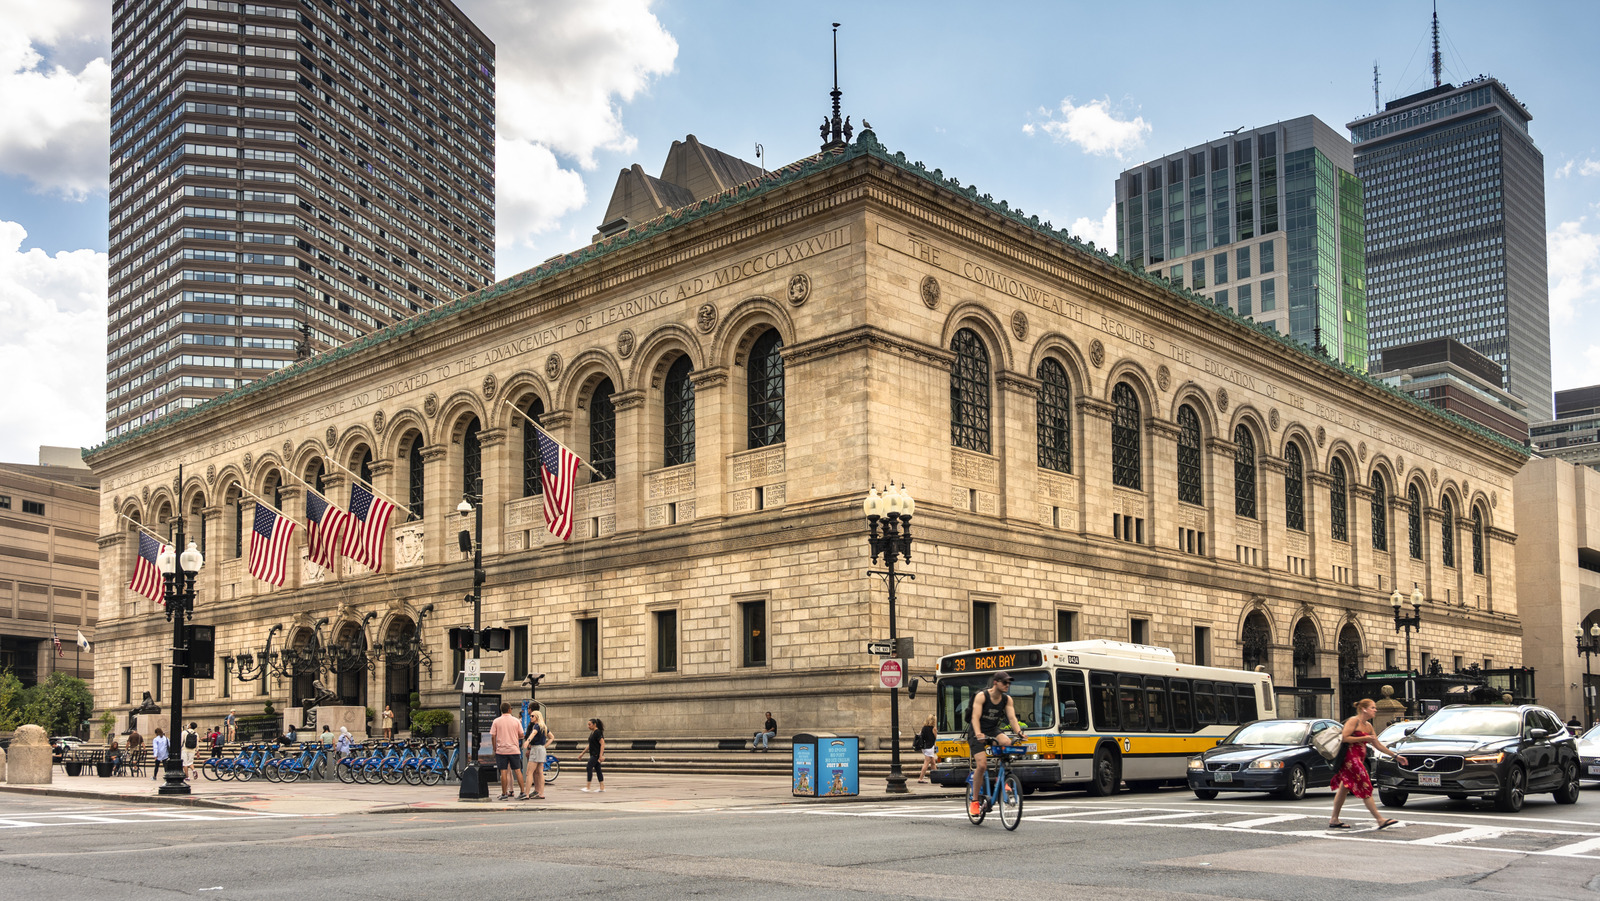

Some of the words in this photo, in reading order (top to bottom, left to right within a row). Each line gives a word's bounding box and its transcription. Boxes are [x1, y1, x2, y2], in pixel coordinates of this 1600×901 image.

[1373, 95, 1468, 129] PRUDENTIAL
[164, 461, 172, 472] OF
[191, 449, 206, 463] CITY
[210, 445, 219, 455] OF
[222, 435, 251, 452] BOSTON
[255, 425, 275, 440] BUILT
[279, 420, 289, 433] BY
[294, 413, 310, 427] THE
[315, 402, 345, 420] PEOPLE
[351, 393, 370, 409] AND
[377, 373, 429, 401] DEDICATED
[437, 364, 450, 380] TO
[456, 357, 478, 374] THE
[484, 324, 567, 366] ADVANCEMENT
[576, 316, 593, 334] OF
[601, 290, 669, 325] LEARNING
[908, 239, 942, 267] THE
[963, 262, 1084, 322] COMMONWEALTH
[1101, 316, 1156, 350] REQUIRES
[1169, 344, 1192, 365] THE
[1204, 358, 1256, 389] EDUCATION
[1266, 384, 1279, 397] OF
[1288, 393, 1305, 410] THE
[1315, 403, 1344, 425] PEOPLE
[1351, 420, 1361, 432] AS
[1368, 425, 1382, 440] THE
[1390, 433, 1424, 456] SAFEGUARD
[1430, 451, 1439, 461] OF
[954, 658, 966, 671] 39
[975, 656, 997, 670] BACK
[999, 654, 1016, 667] BAY
